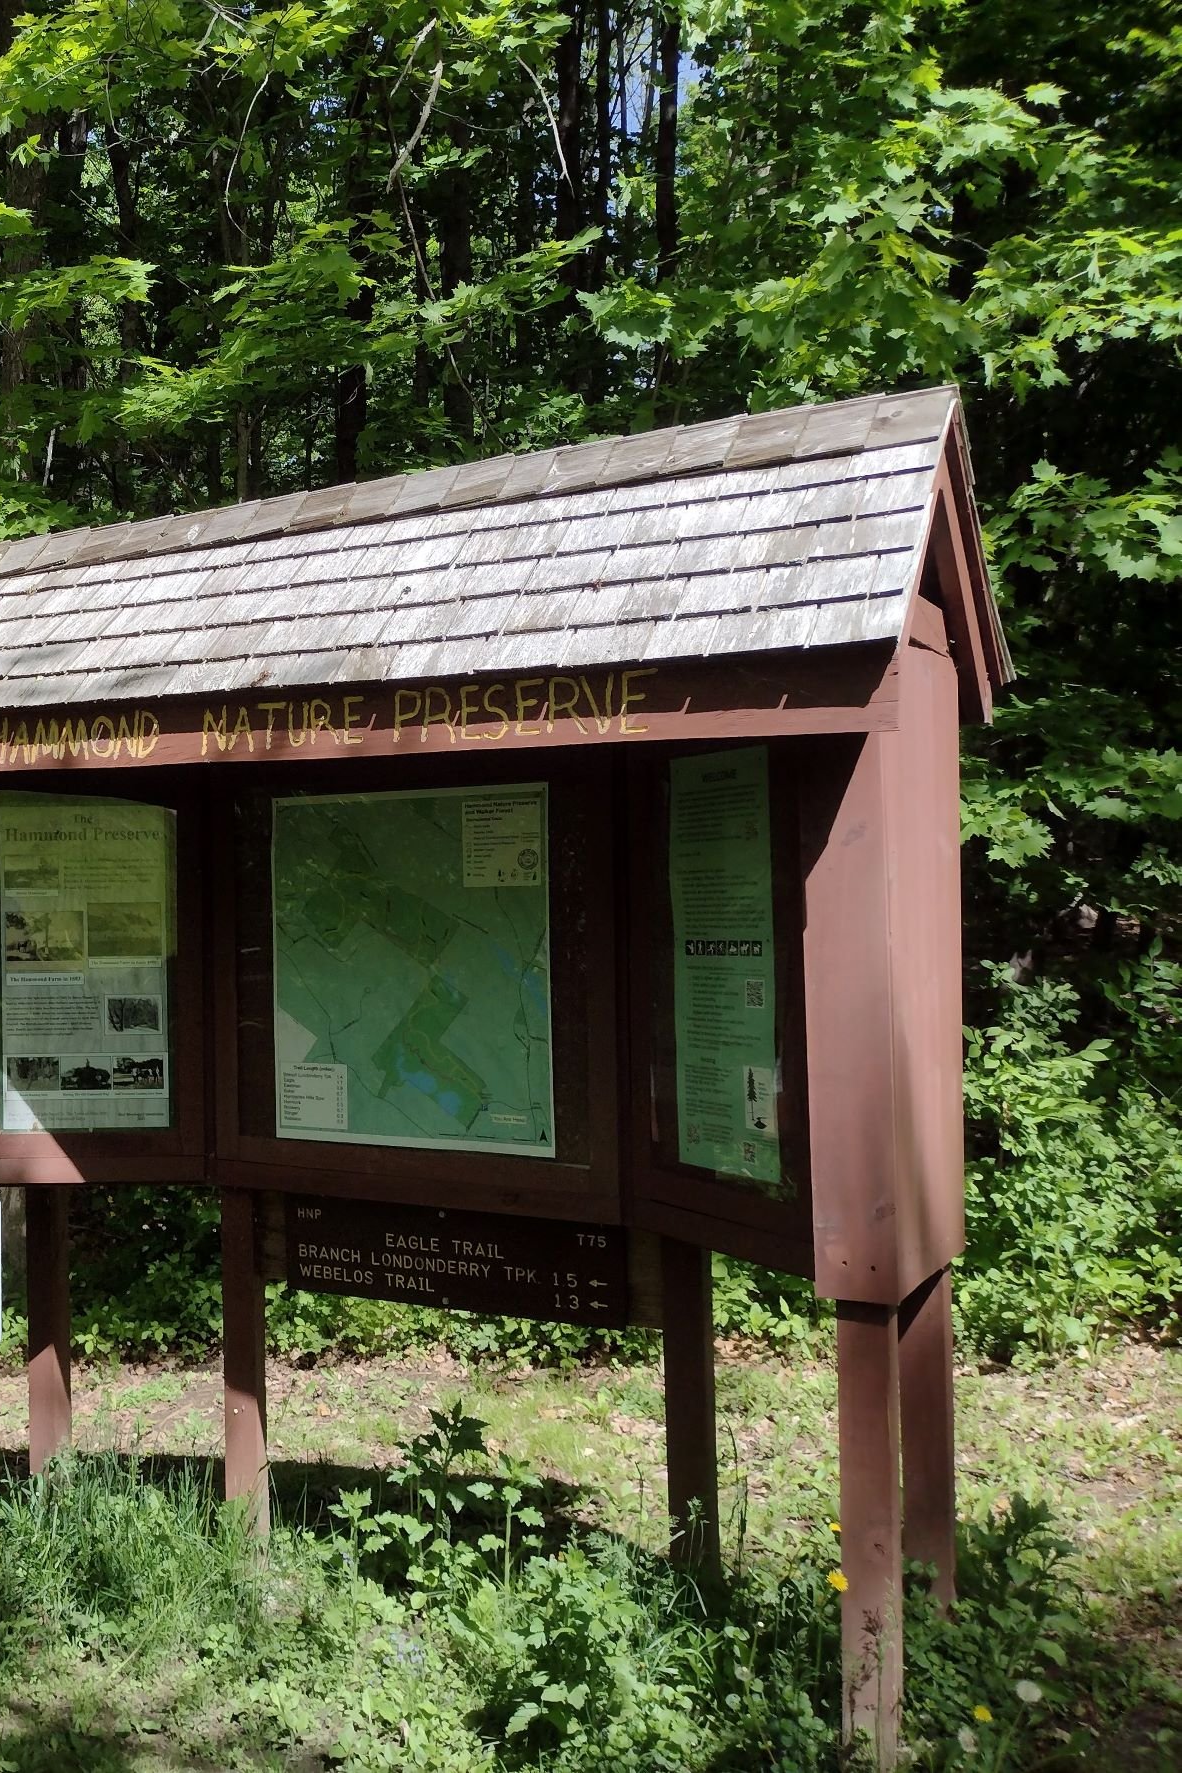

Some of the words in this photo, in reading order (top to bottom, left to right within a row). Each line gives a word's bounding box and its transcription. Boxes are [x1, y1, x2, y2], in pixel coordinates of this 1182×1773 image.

[201, 695, 364, 756] NATURE
[393, 667, 659, 744] PRESERVE
[74, 814, 94, 825] The
[4, 828, 88, 842] Hammond
[93, 827, 160, 842] Preserve
[298, 1208, 322, 1219] HNP
[385, 1232, 440, 1253] EAGLE
[452, 1239, 505, 1260] TRAIL
[577, 1233, 607, 1248] T75
[298, 1243, 361, 1264] BRANCH
[371, 1251, 491, 1279] LONDONDERRY
[299, 1263, 374, 1285] WEBELOS
[385, 1273, 435, 1293] TRAIL
